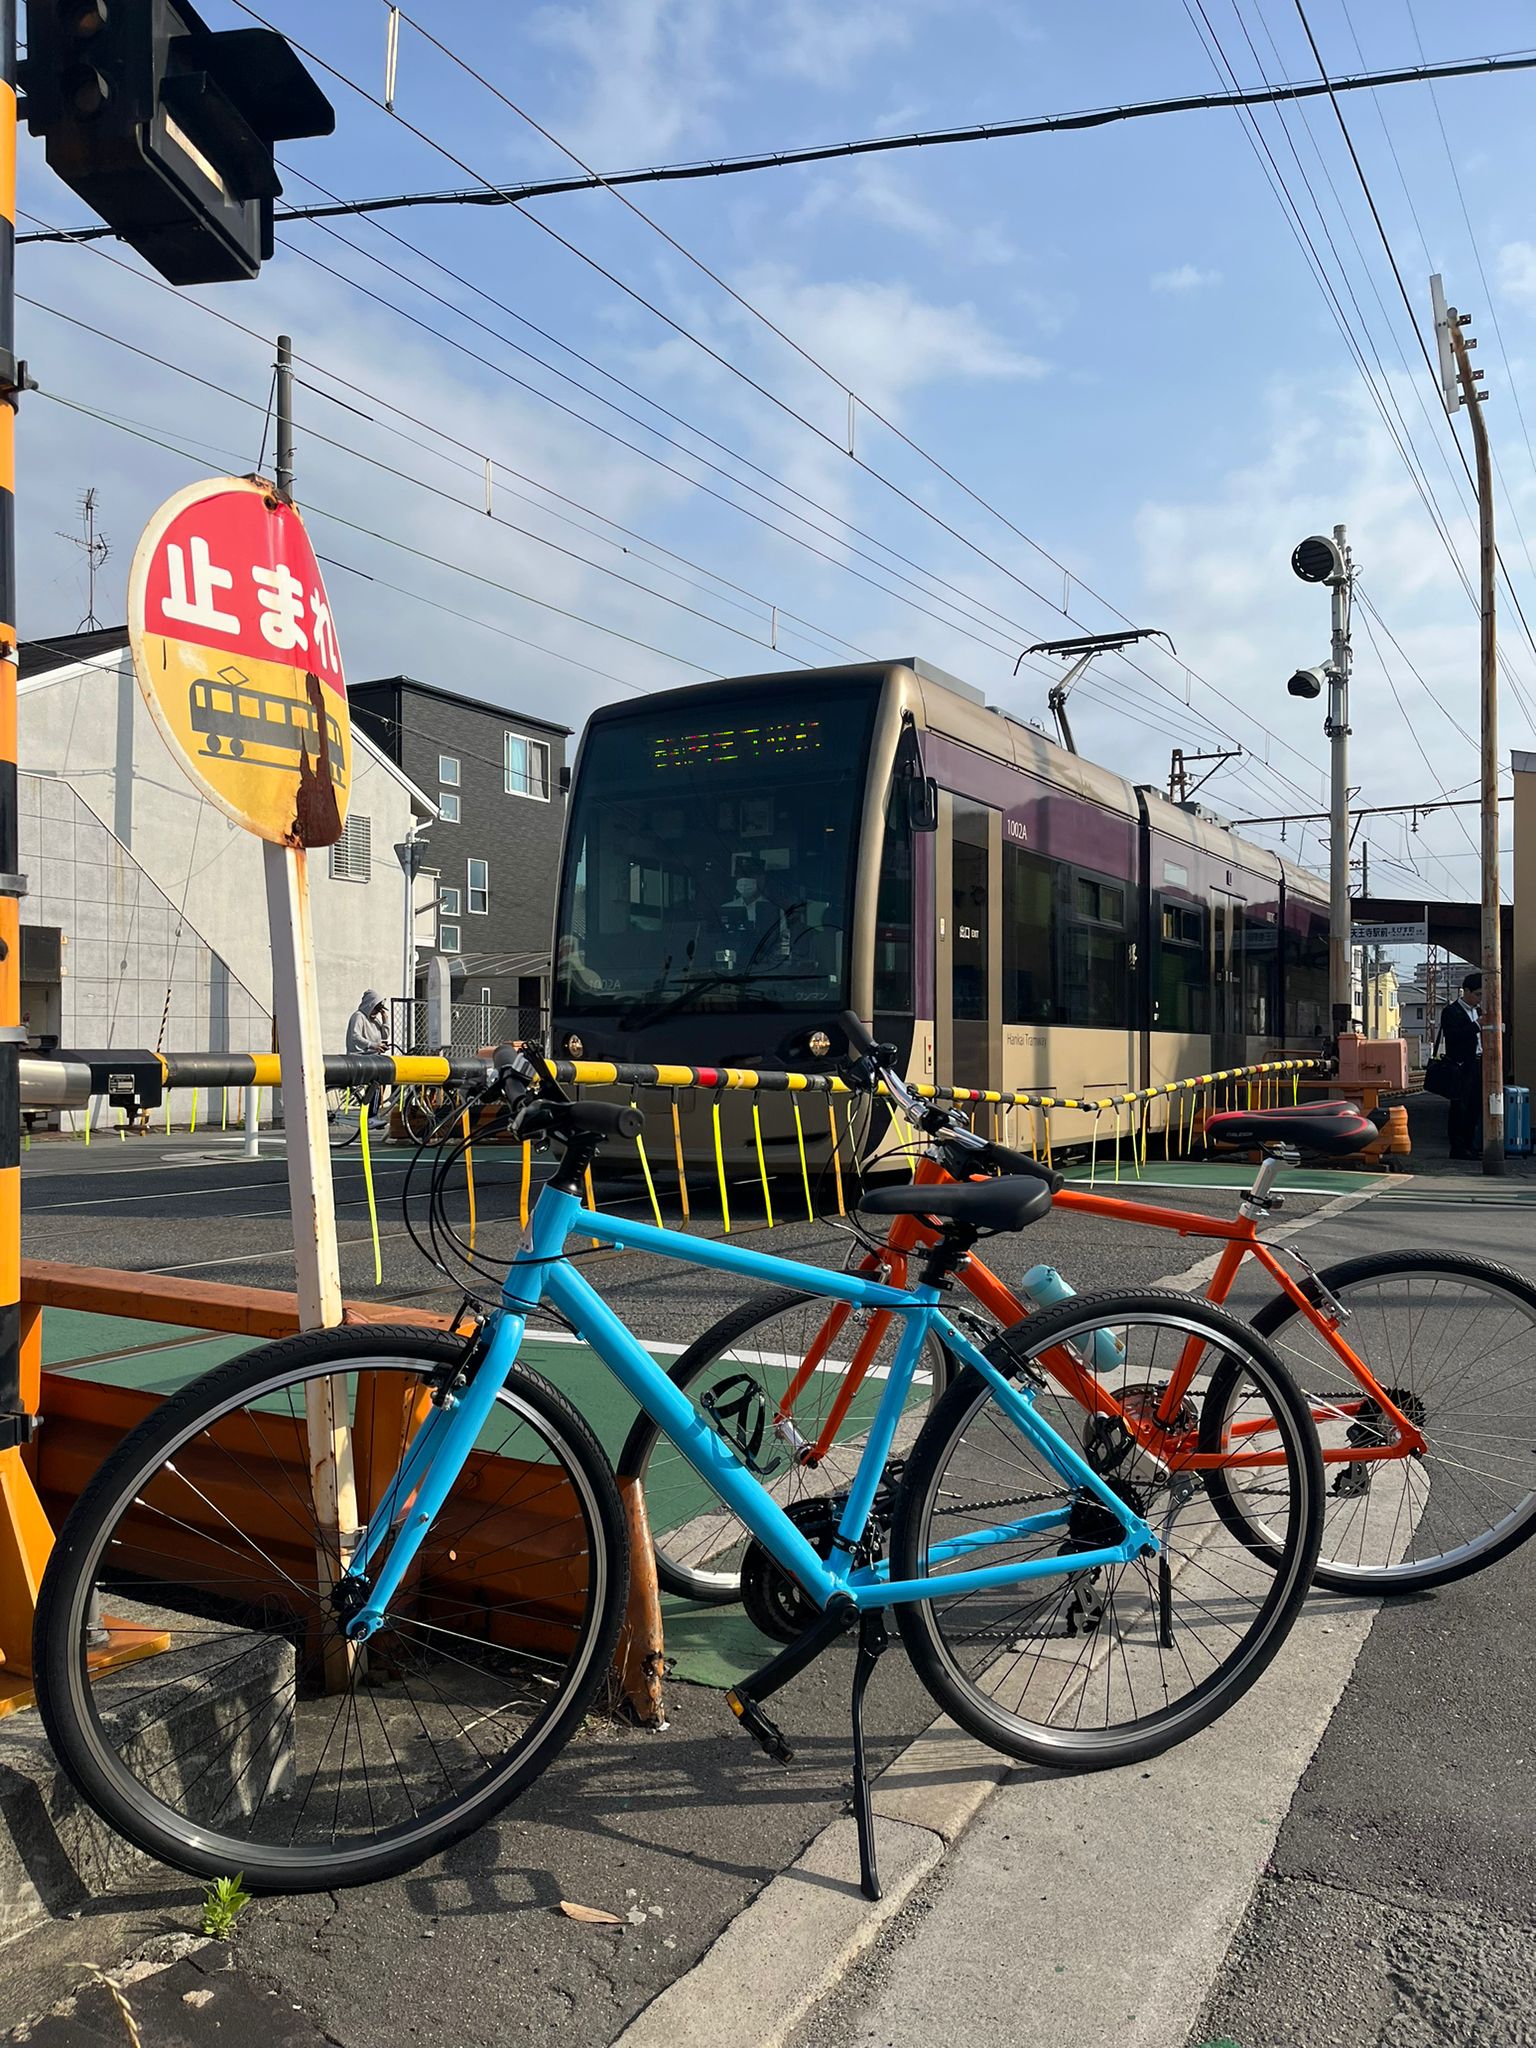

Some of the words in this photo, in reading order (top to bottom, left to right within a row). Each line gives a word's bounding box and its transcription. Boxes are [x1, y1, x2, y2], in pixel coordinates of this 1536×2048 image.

[161, 535, 338, 674] 止まれ
[1007, 819, 1028, 840] 1002A
